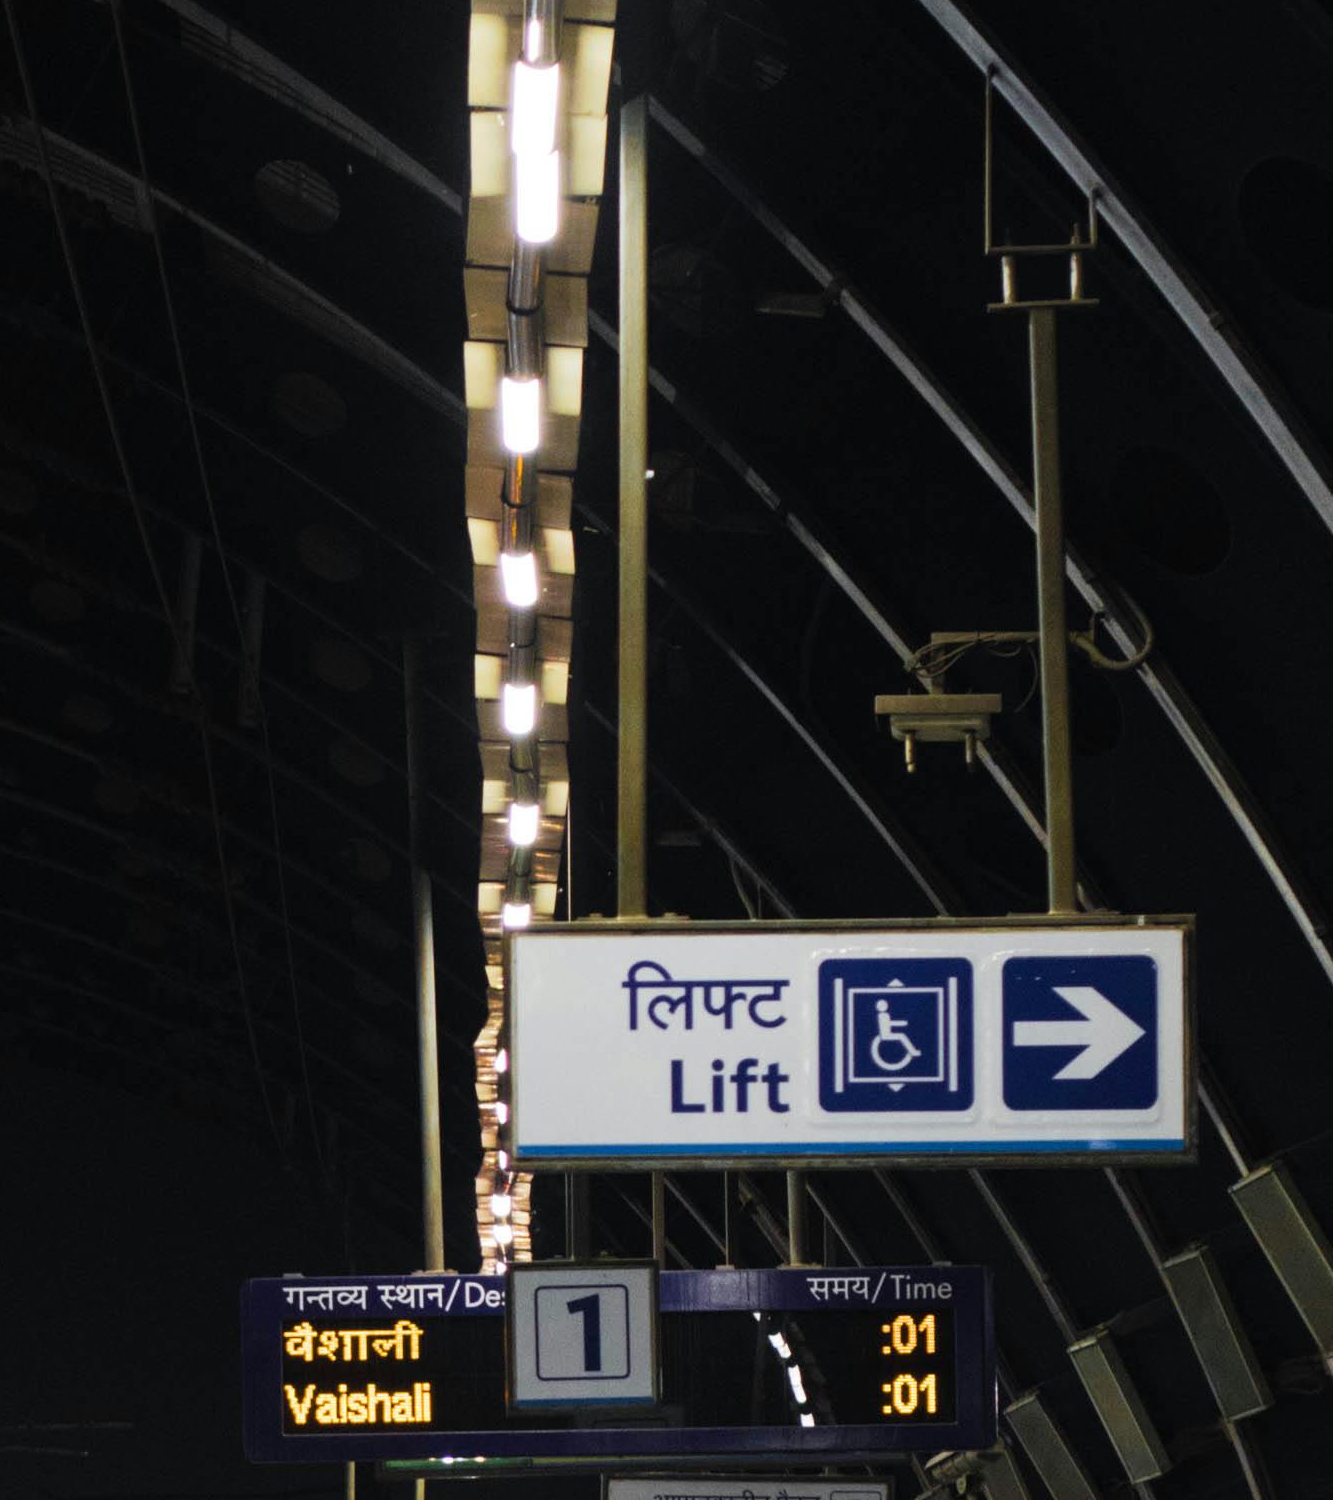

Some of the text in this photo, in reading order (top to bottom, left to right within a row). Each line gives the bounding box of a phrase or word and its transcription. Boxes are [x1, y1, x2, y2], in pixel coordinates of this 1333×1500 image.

[622, 960, 790, 1030] लिफ्ट
[671, 1058, 790, 1113] Lift
[283, 1286, 368, 1311] गन्तव्य
[284, 1320, 424, 1362] वैशाली
[566, 1294, 601, 1372] 1
[883, 1314, 935, 1353] :01
[284, 1382, 431, 1424] Vaishali
[883, 1374, 937, 1414] :01
